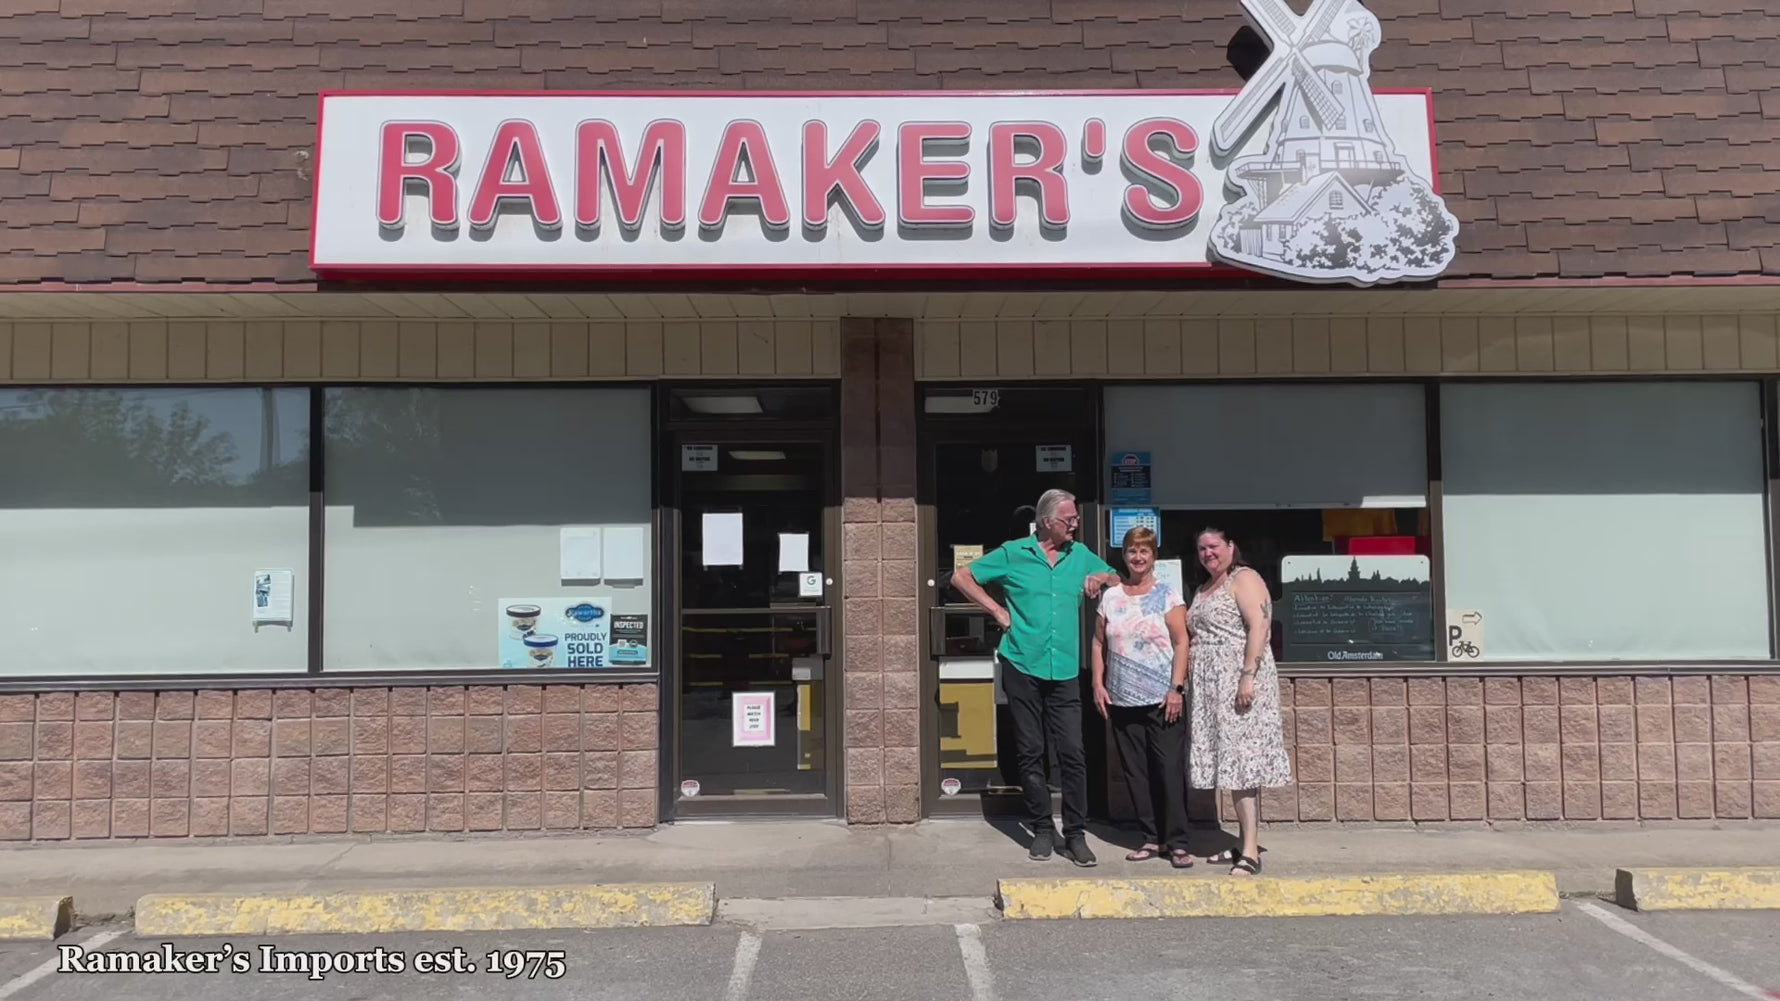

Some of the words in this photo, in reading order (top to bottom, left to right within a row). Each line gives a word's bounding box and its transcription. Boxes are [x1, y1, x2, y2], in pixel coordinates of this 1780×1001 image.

[376, 117, 1204, 227] RAMAKER'S
[974, 391, 997, 406] 579
[614, 621, 644, 629] INSPECTED
[565, 632, 607, 641] PROUDLY
[1449, 625, 1462, 646] P
[567, 643, 604, 655] SOLD
[567, 656, 604, 667] HERE
